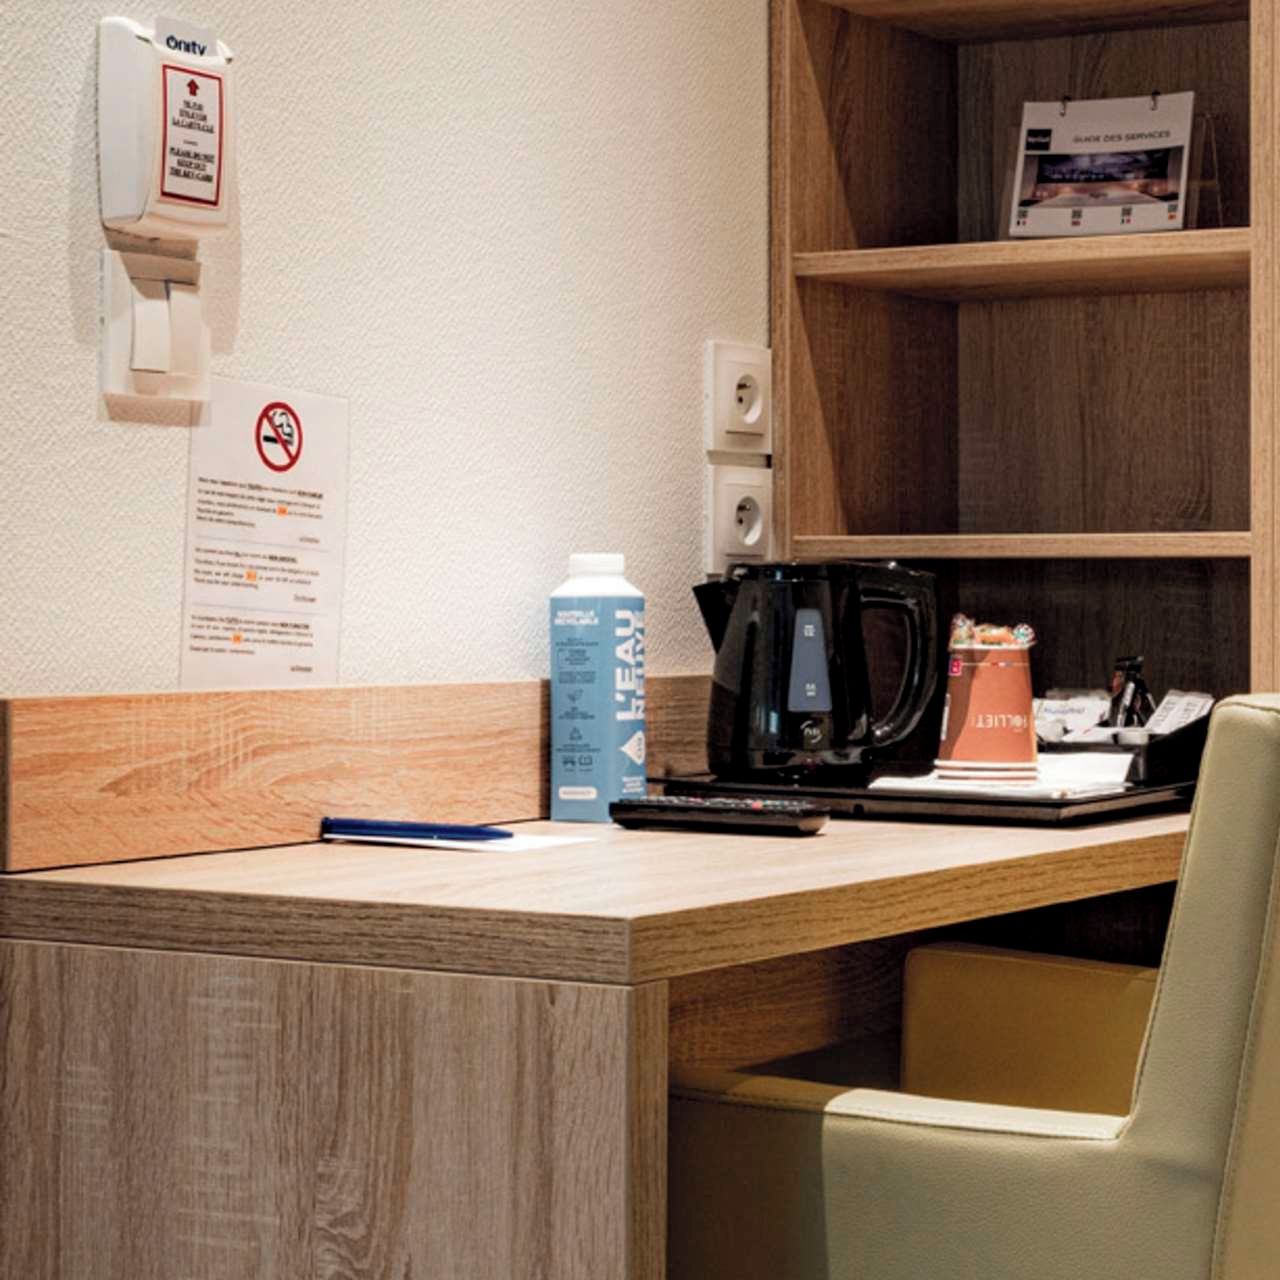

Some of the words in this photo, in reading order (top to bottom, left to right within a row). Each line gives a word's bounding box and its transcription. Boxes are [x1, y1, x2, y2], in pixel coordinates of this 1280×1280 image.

[1103, 133, 1122, 142] DES
[1125, 130, 1170, 142] SERVICES
[615, 609, 636, 721] L'EAU
